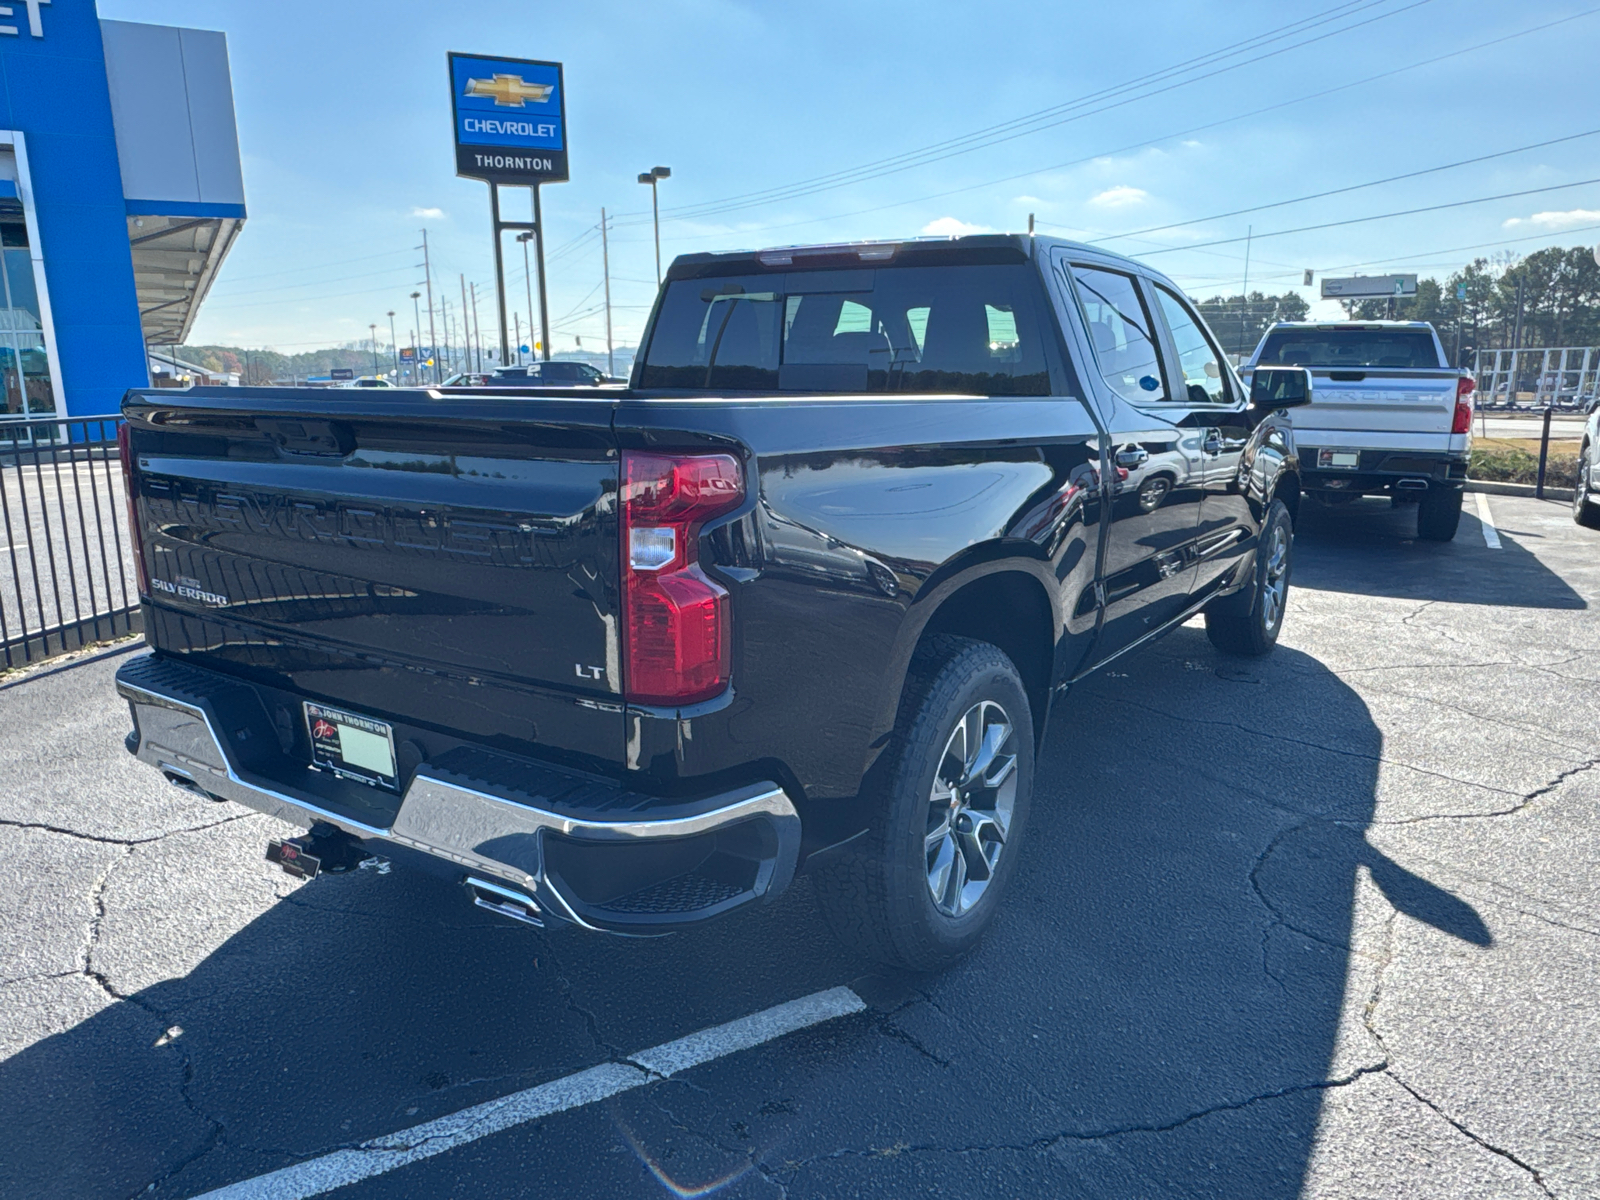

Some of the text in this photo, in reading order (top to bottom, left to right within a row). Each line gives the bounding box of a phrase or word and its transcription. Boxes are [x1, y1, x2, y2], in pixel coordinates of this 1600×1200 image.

[464, 118, 556, 138] CHEVROLET
[475, 154, 552, 171] THORNTON
[1313, 390, 1442, 403] VROLET
[151, 578, 228, 605] SILVERADO
[575, 663, 605, 680] LT
[322, 709, 387, 735] JOHN THORNTON
